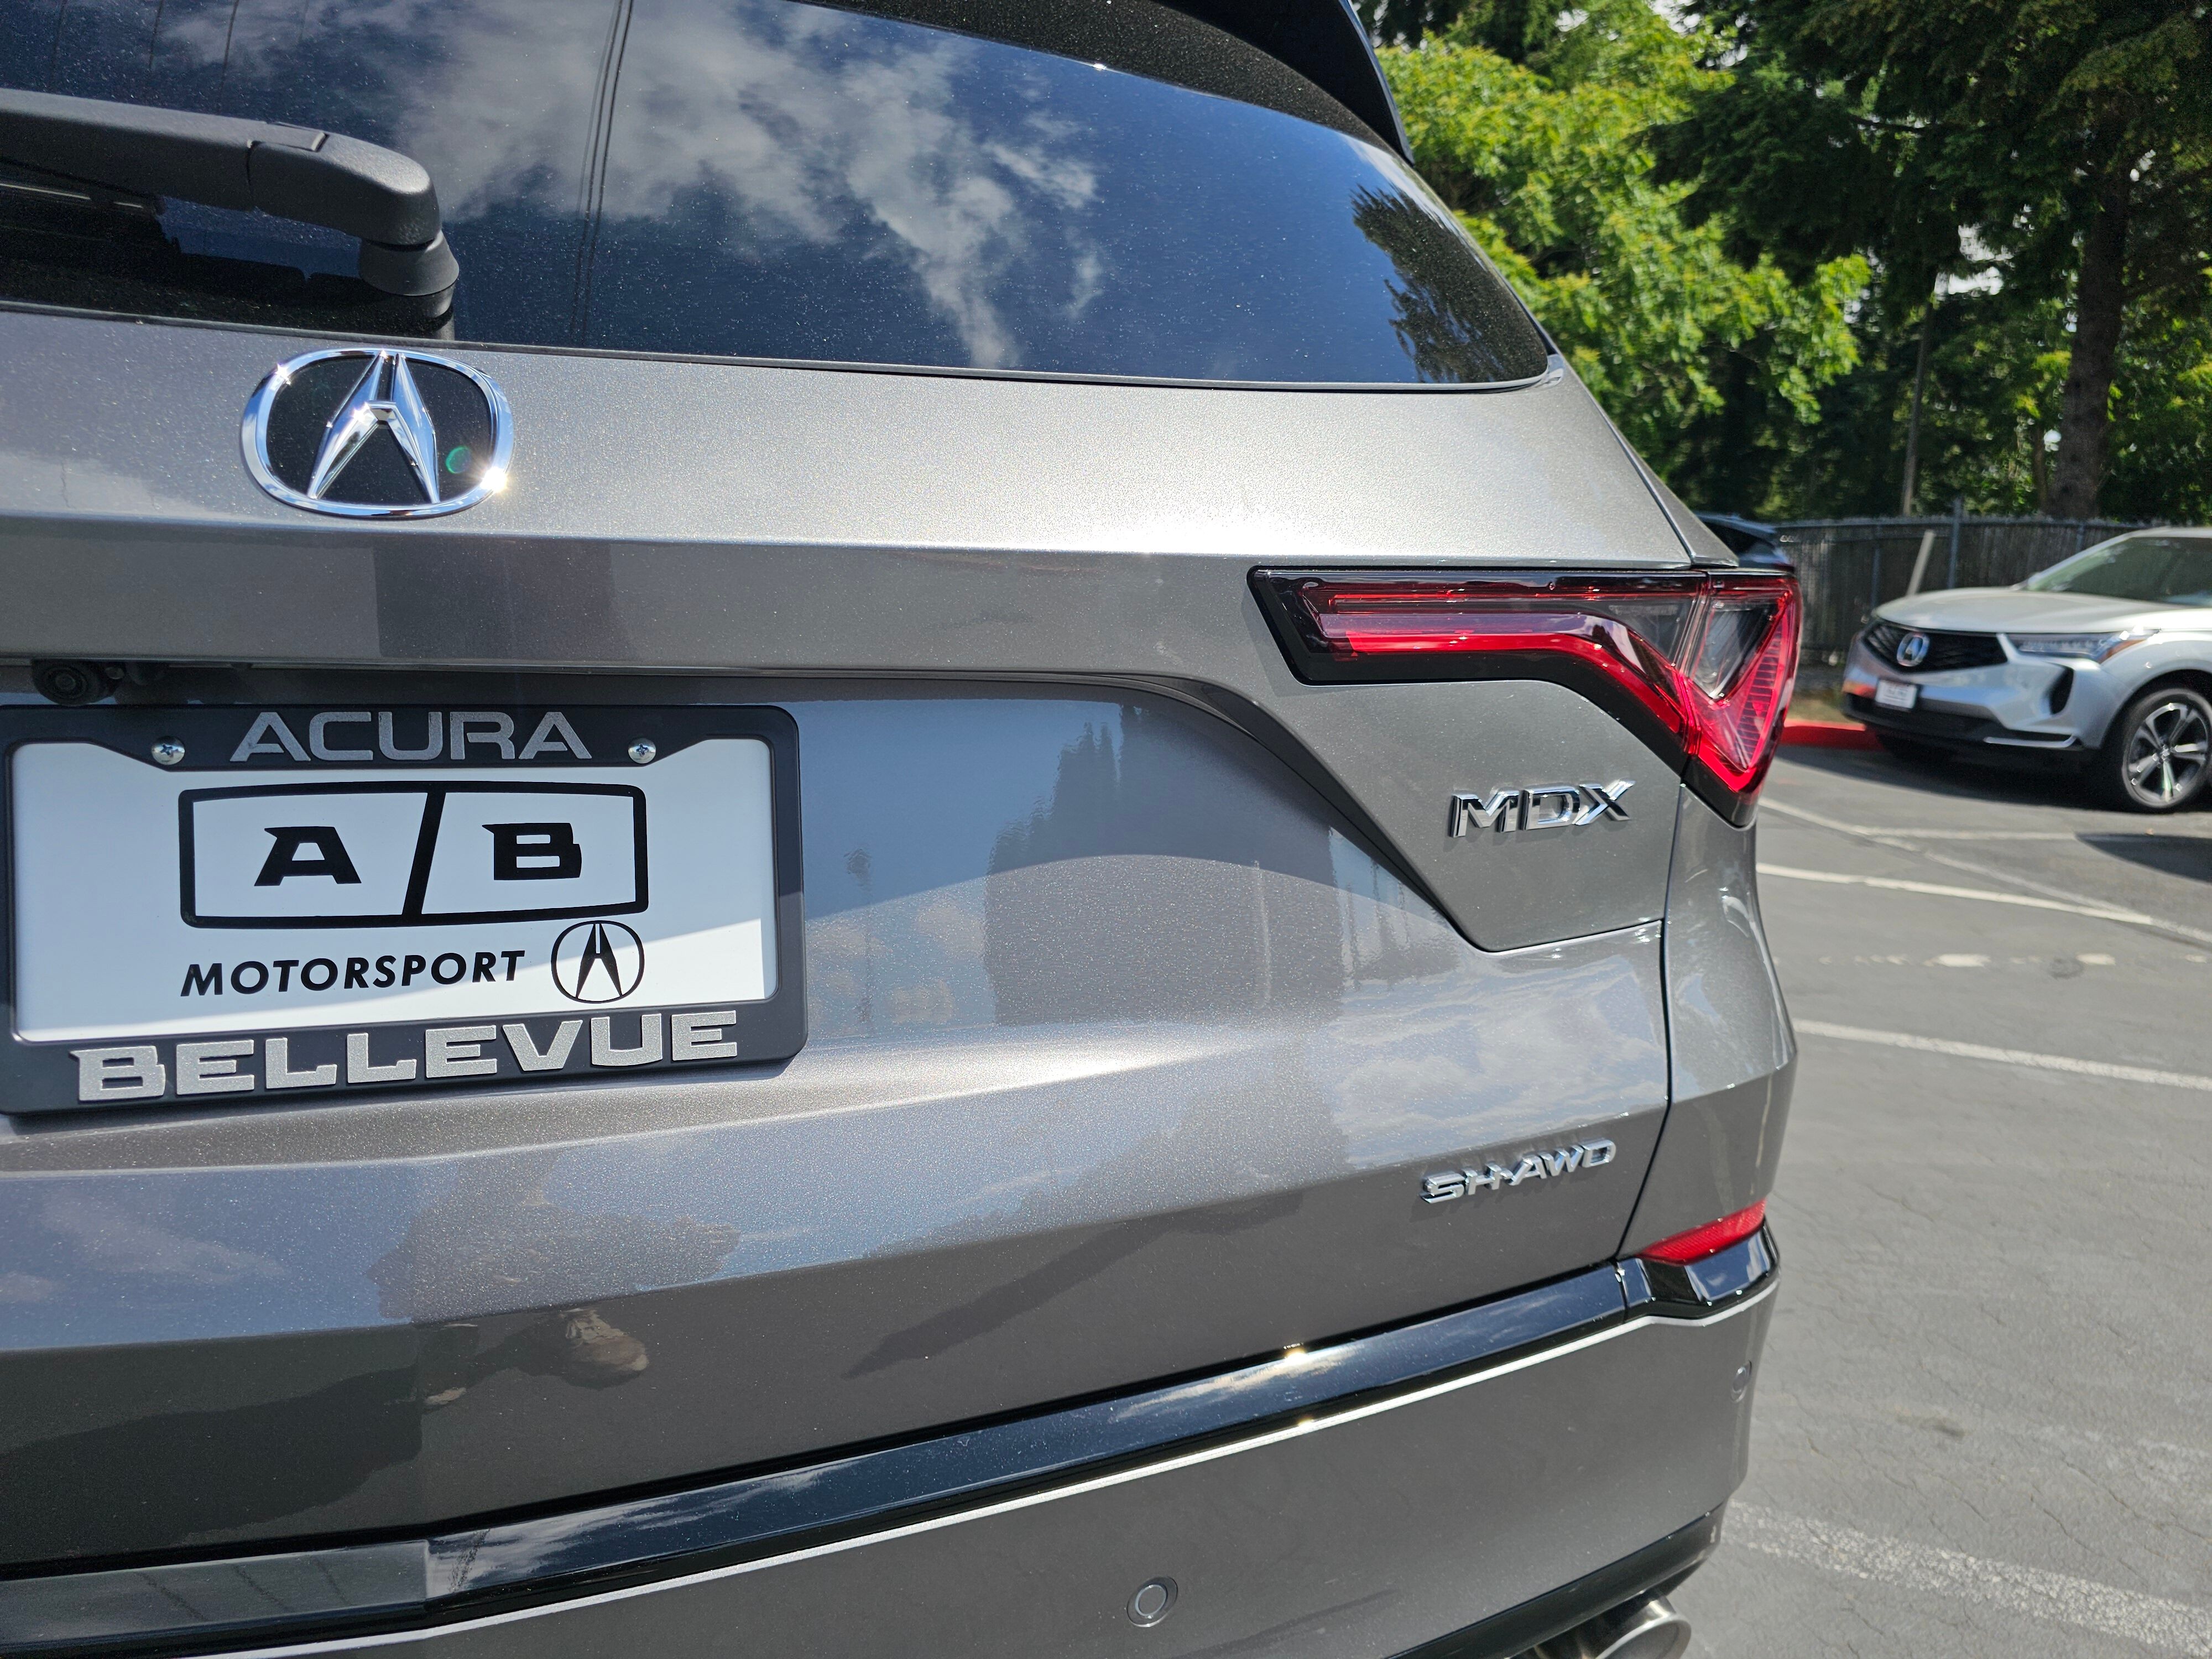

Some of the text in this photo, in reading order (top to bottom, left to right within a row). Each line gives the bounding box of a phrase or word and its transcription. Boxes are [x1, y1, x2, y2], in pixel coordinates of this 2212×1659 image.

[231, 712, 592, 762] ACURA
[1448, 778, 1636, 838] MDX
[180, 950, 525, 997] MOTORSPORT
[69, 1010, 738, 1102] BELLEVUE
[1420, 1139, 1617, 1204] SH-AWD
